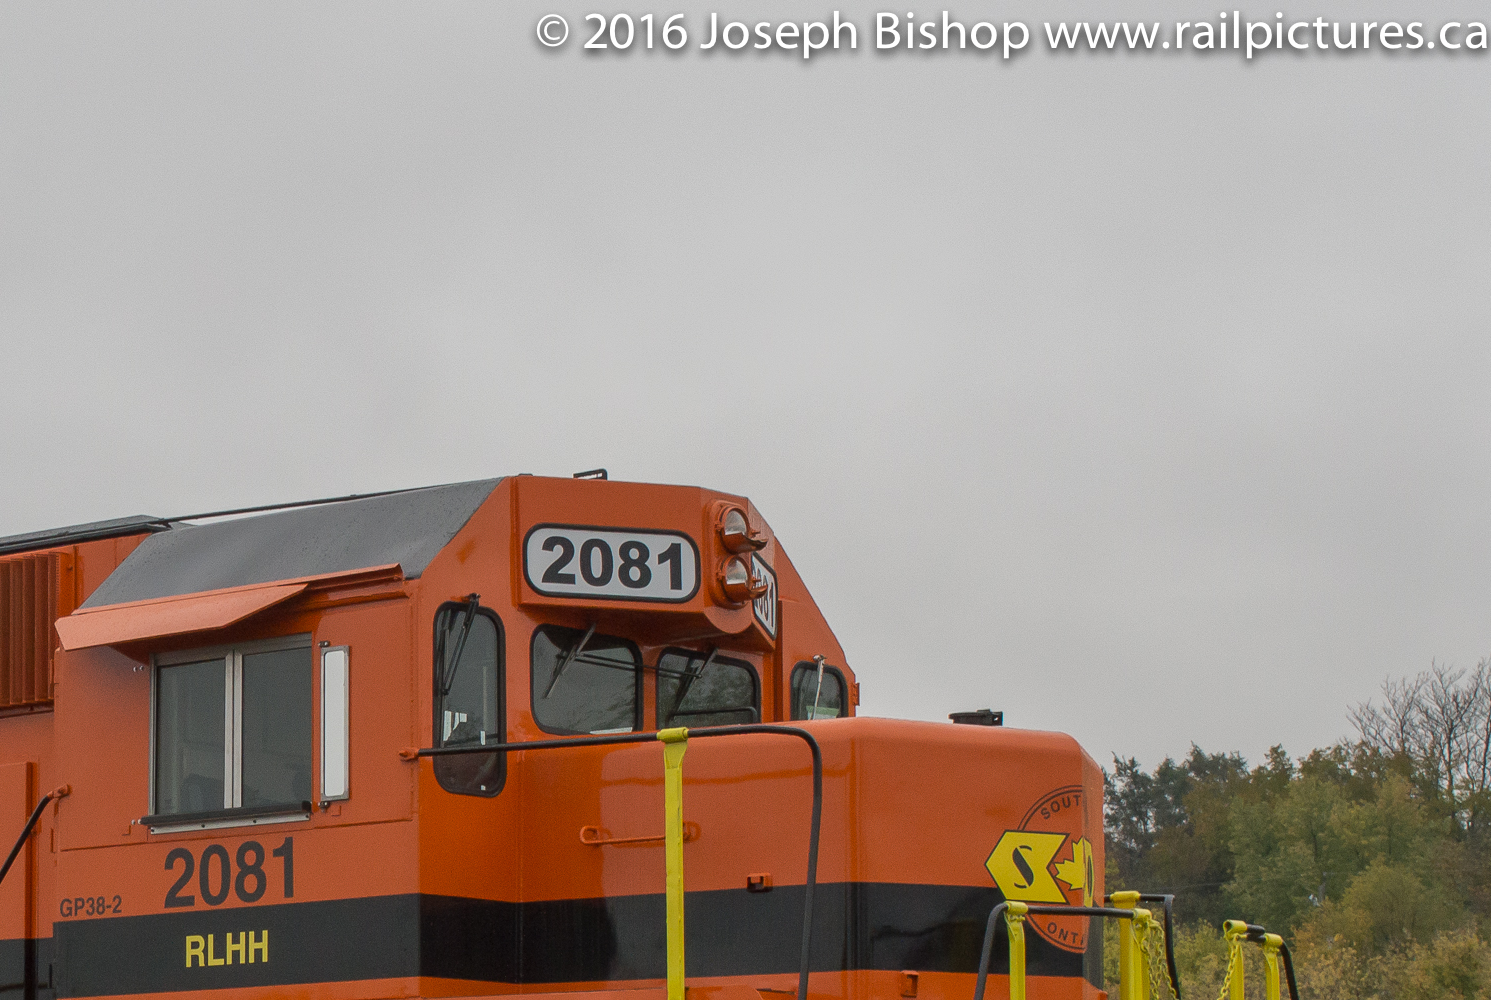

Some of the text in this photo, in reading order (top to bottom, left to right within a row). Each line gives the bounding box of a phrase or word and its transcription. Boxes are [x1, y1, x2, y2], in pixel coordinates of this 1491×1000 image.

[541, 535, 683, 591] 2081
[1040, 795, 1082, 820] SOUT
[164, 836, 294, 909] 2081
[1012, 845, 1035, 889] S
[59, 894, 123, 918] GP38-2
[185, 929, 269, 968] RLHH
